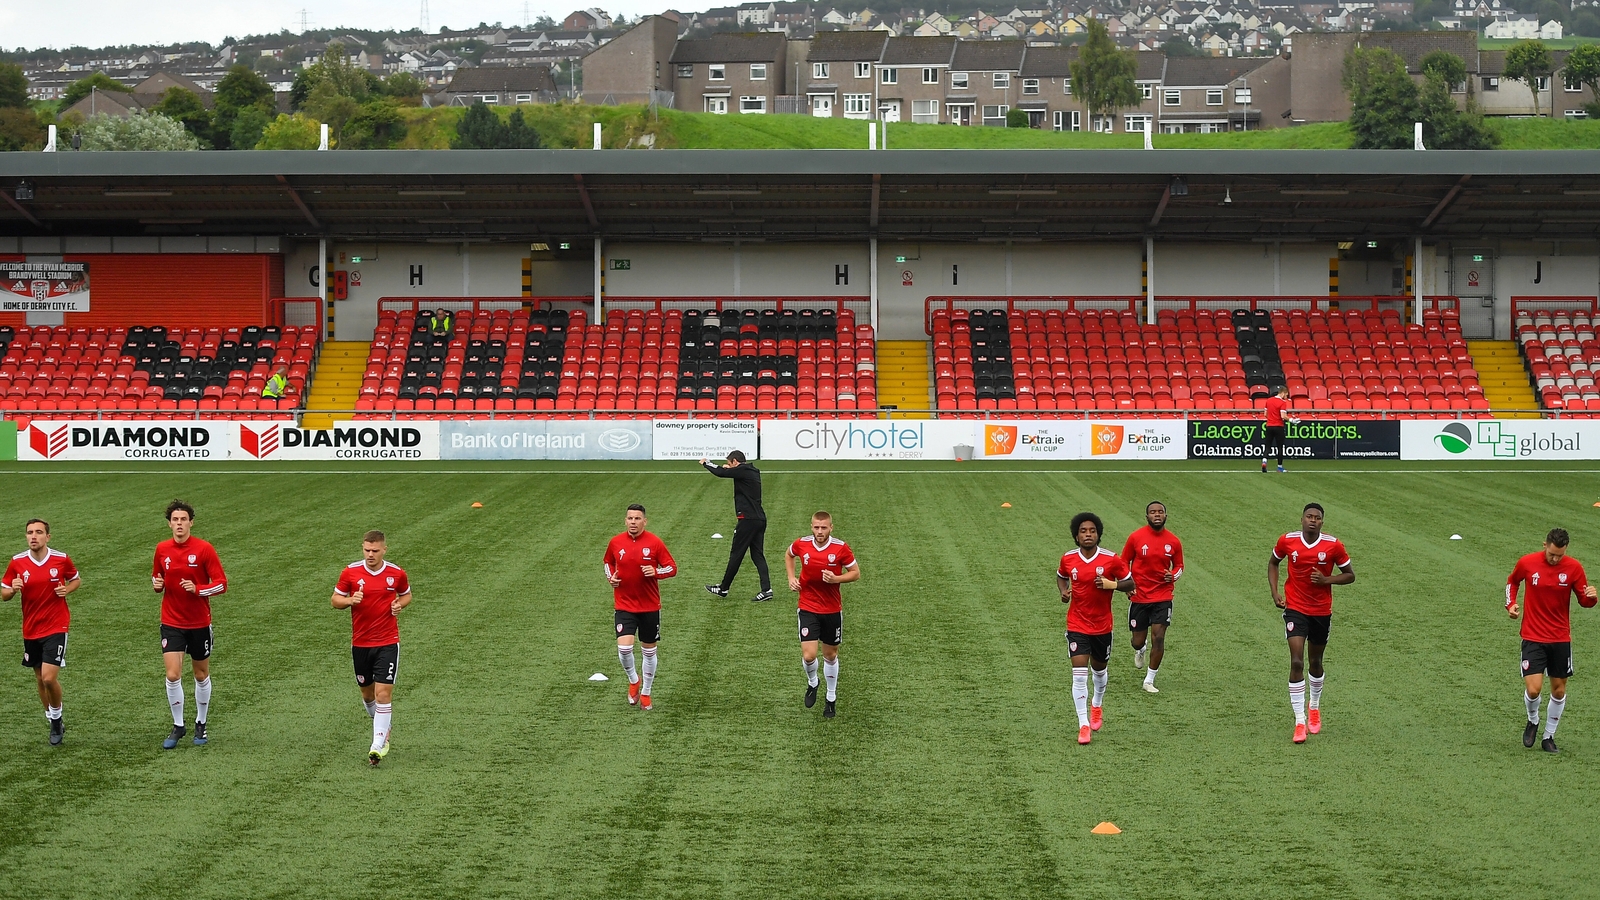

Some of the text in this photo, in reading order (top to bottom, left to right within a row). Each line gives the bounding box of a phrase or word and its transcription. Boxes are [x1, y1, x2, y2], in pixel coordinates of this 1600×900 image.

[8, 272, 72, 280] BRANDYWELL STADIUM
[308, 266, 320, 287] G
[410, 264, 422, 286] H
[835, 264, 848, 285] H
[1534, 261, 1541, 284] J
[4, 302, 20, 310] HOME
[22, 302, 30, 310] OF
[30, 302, 51, 310] DERRY
[656, 422, 685, 430] downey
[72, 427, 210, 448] DIAMOND
[282, 427, 421, 448] DIAMOND
[1193, 422, 1362, 443] Lacey licitors.
[452, 432, 585, 448] Bank of Ireland
[1022, 434, 1064, 444] Extra.ie
[1128, 434, 1170, 444] Extra.ie
[1520, 432, 1580, 456] global
[124, 449, 210, 458] CORRUGATED
[336, 449, 422, 458] CORRUGATED
[1193, 444, 1242, 456] Claims
[204, 640, 209, 650] 6
[388, 662, 394, 674] 2
